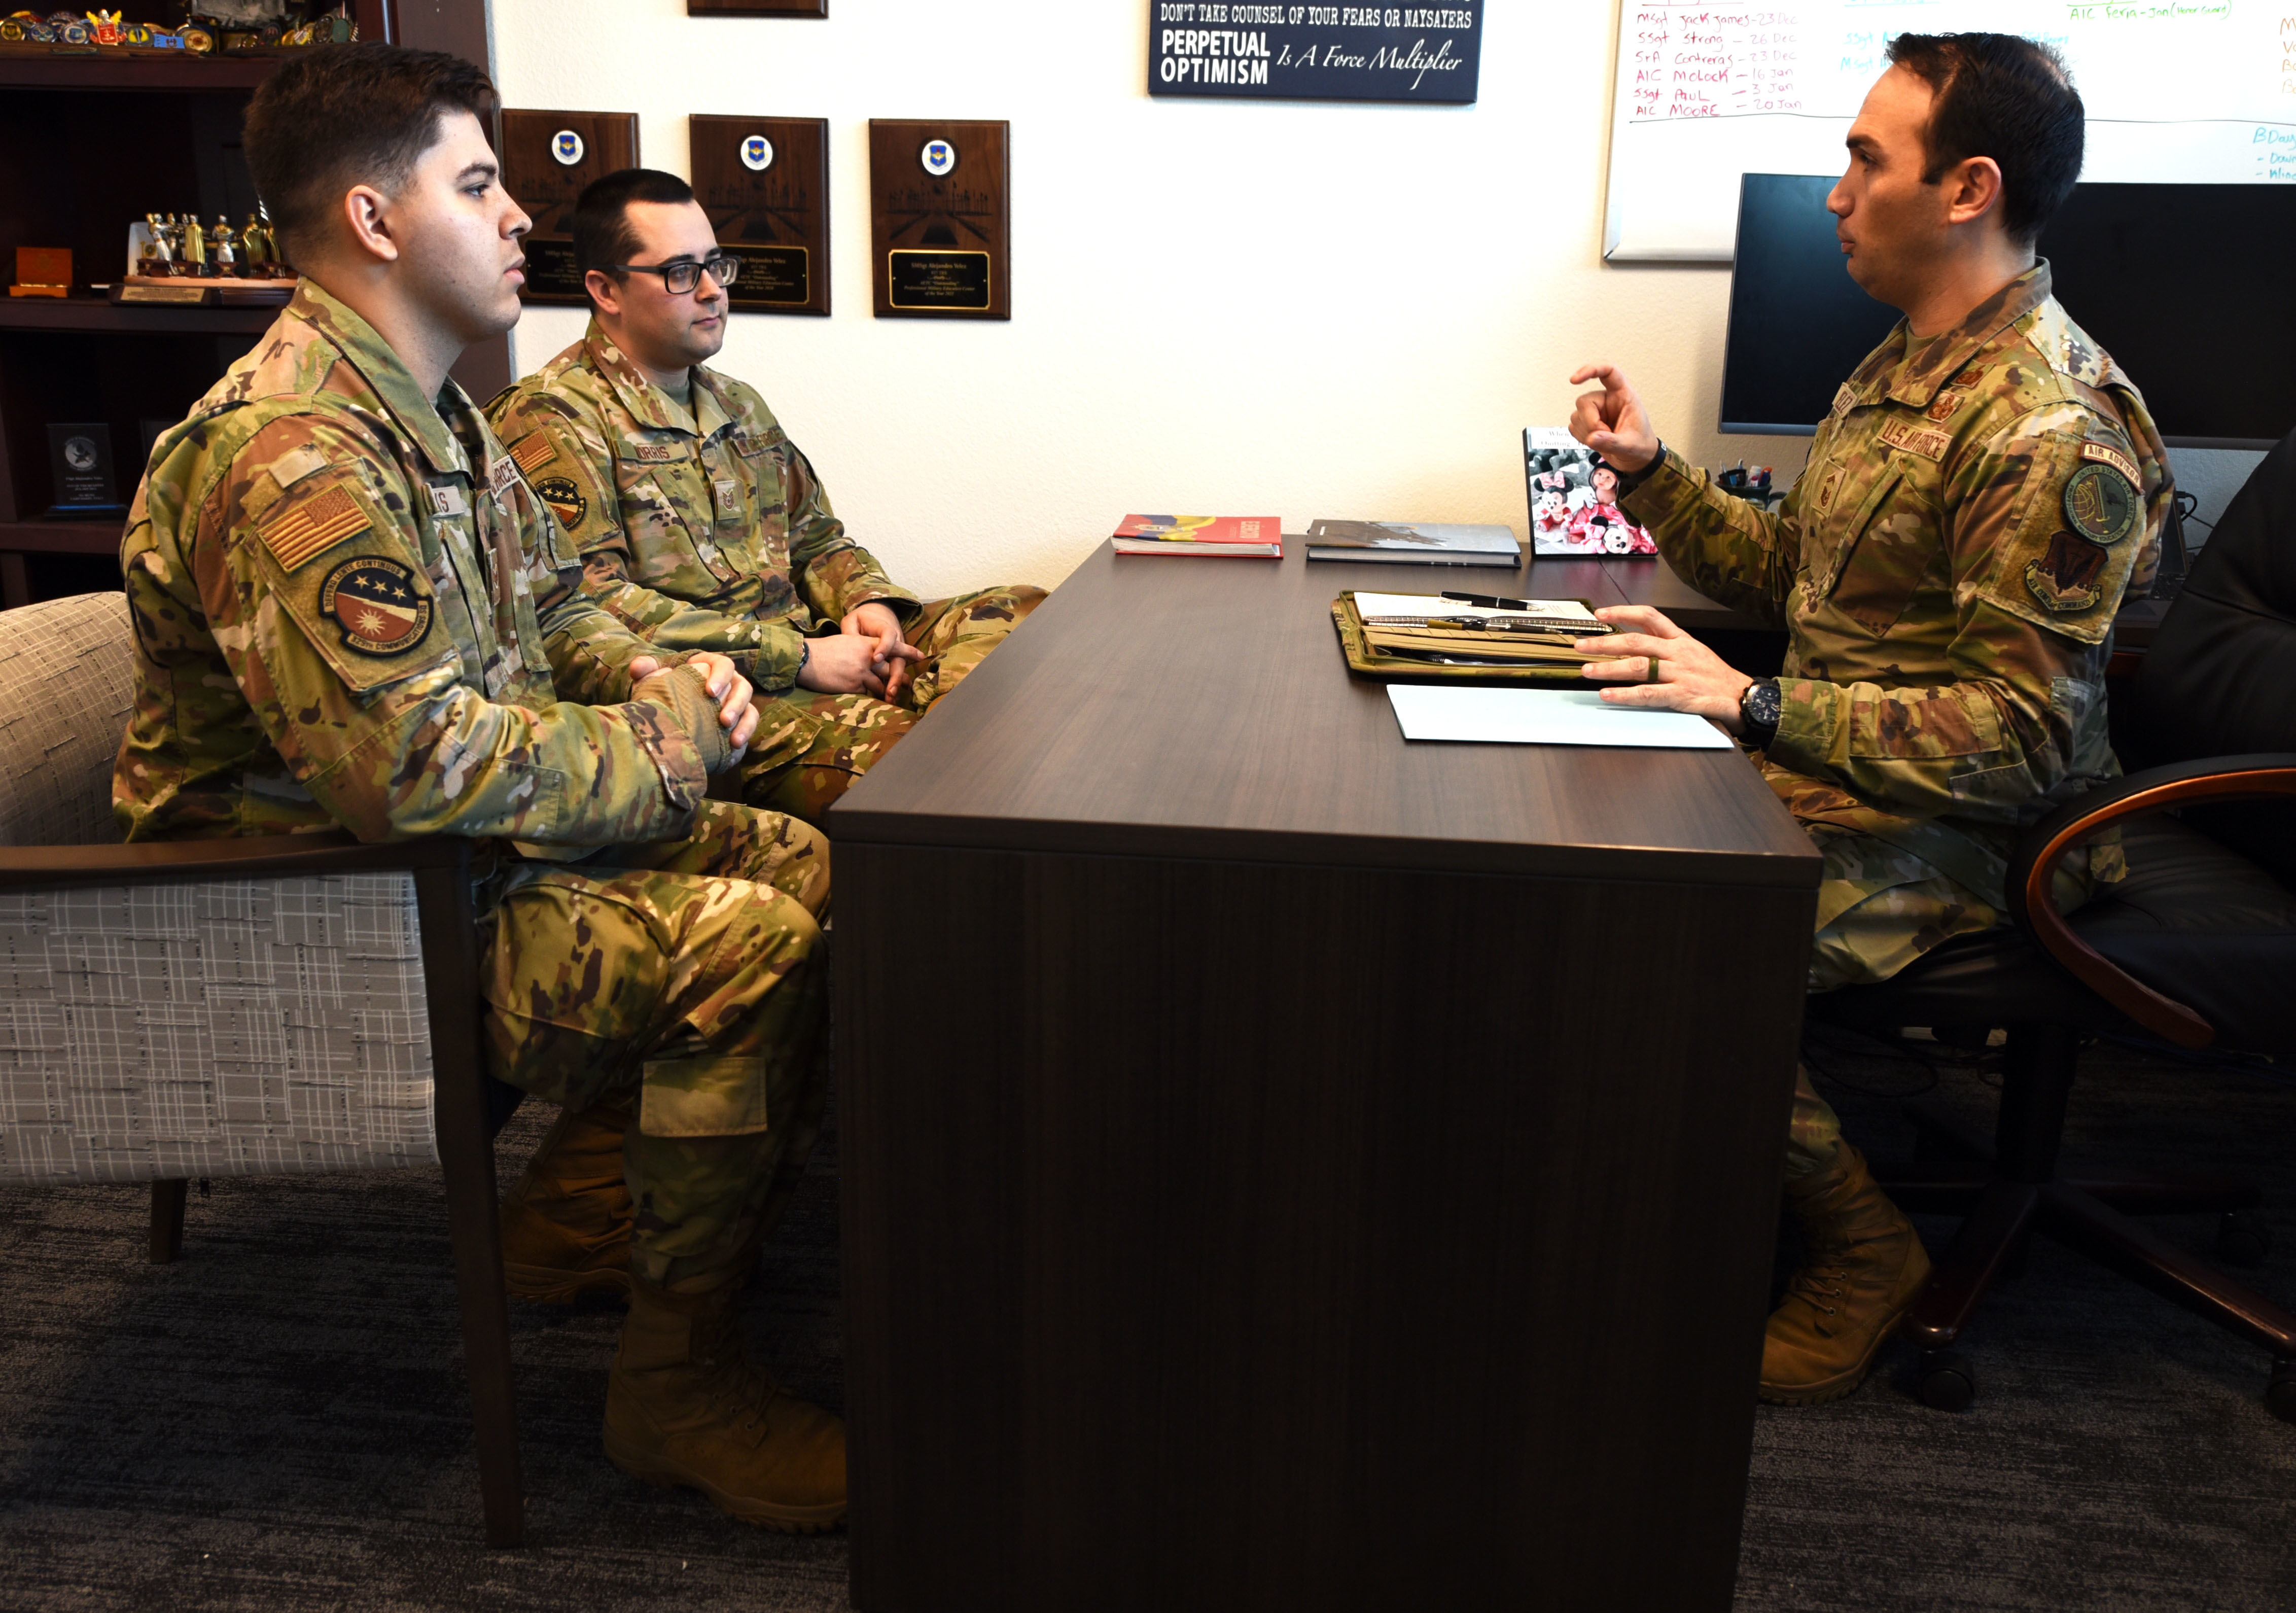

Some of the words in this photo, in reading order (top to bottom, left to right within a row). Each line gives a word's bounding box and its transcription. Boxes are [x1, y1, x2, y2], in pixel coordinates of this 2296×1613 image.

[1161, 3, 1195, 21] DON'T
[1198, 5, 1228, 22] TAKE
[1231, 6, 1285, 24] COUNSEL
[1289, 7, 1305, 24] OF
[1308, 7, 1338, 25] YOUR
[1341, 8, 1381, 27] FEARS
[1384, 9, 1401, 27] OR
[1404, 9, 1472, 29] NAYSAYERS
[1162, 29, 1271, 57] PERPETUAL
[1750, 33, 1768, 45] 26
[1773, 33, 1798, 44] Dec
[1276, 44, 1292, 66] Is
[1295, 44, 1317, 69] A
[1322, 45, 1367, 67] Force
[1368, 38, 1463, 90] Multiplier
[1675, 52, 1733, 68] Contreras
[1750, 51, 1768, 61] 23
[1773, 50, 1797, 61] Dec
[1160, 57, 1268, 85] OPTIMISM
[1770, 68, 1793, 78] Jan
[1768, 83, 1794, 93] Jan
[1753, 98, 1774, 110] 20
[1777, 99, 1802, 110] Jan
[2088, 445, 2104, 458] AIR
[2108, 451, 2140, 483] ADVISOR
